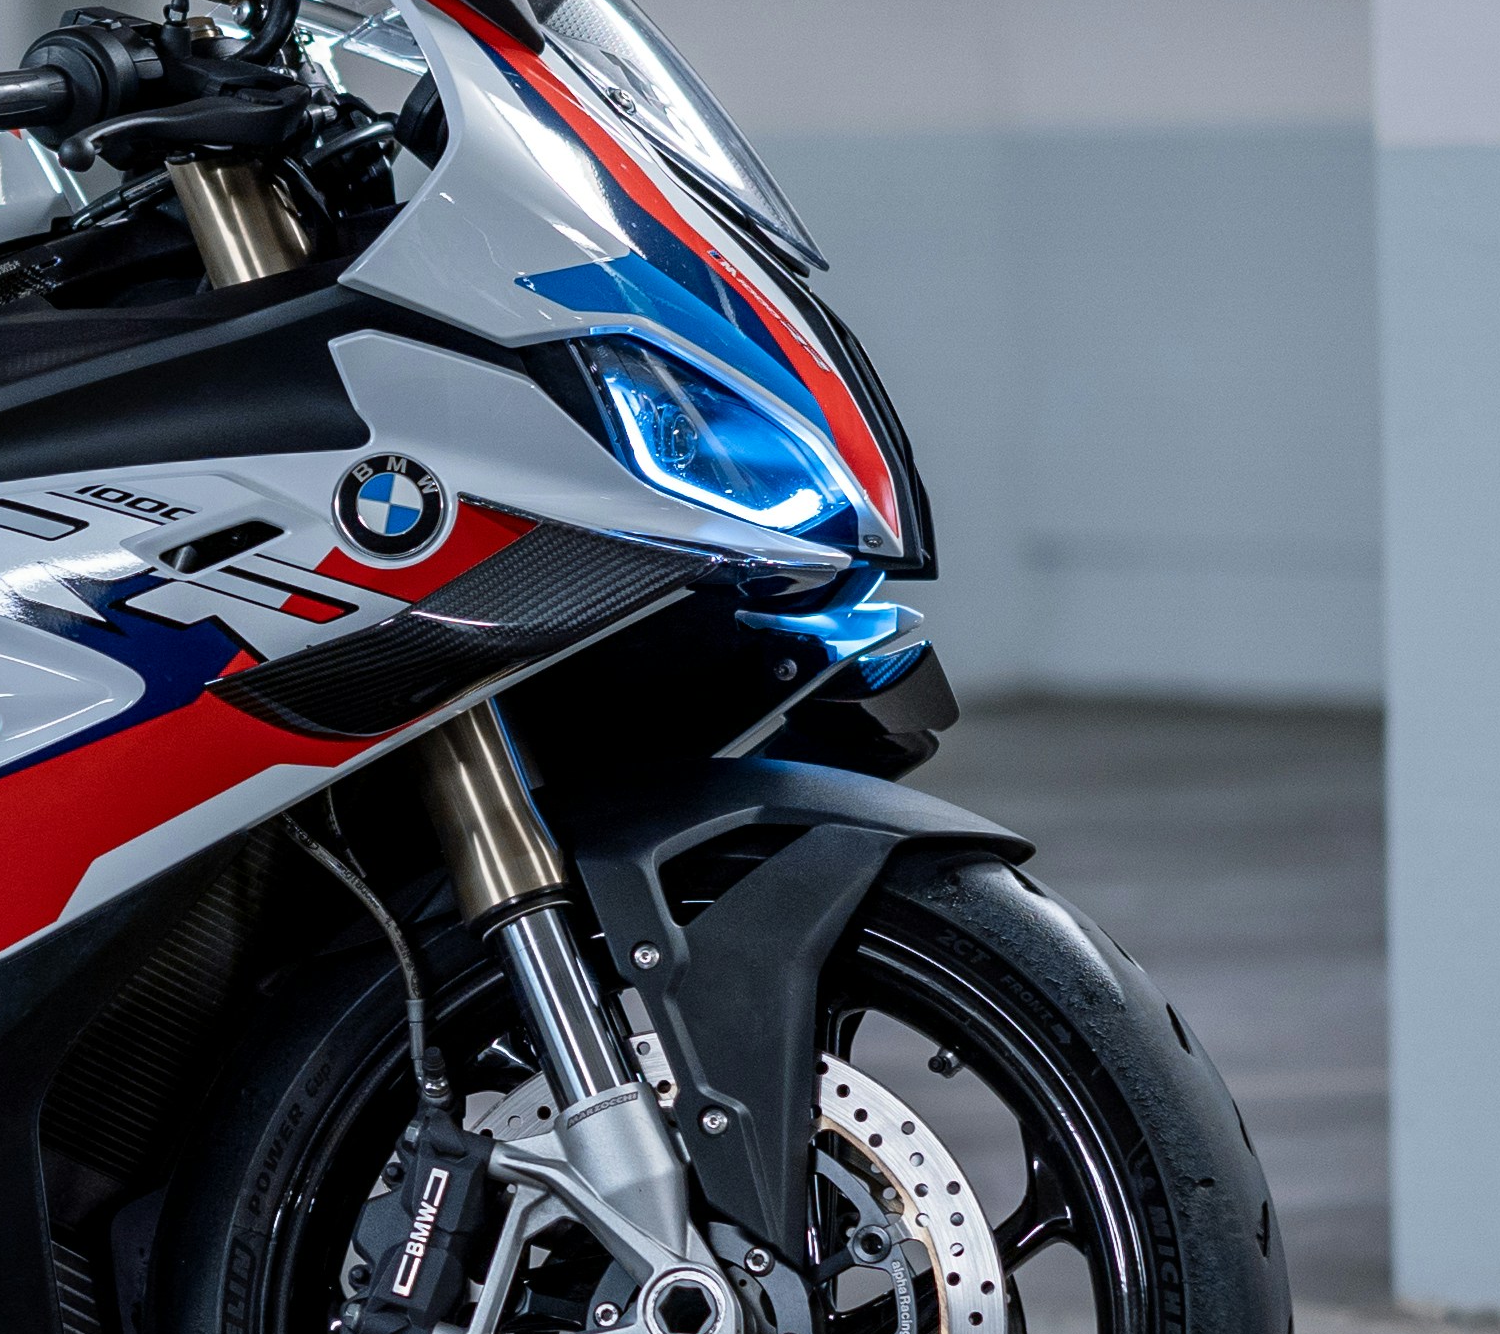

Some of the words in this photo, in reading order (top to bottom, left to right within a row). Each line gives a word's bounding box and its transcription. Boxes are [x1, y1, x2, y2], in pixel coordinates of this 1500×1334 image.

[352, 456, 439, 495] BMW
[566, 1090, 639, 1130] MARZOCCHI
[248, 1103, 304, 1217] POWER
[404, 1200, 438, 1258] BMW
